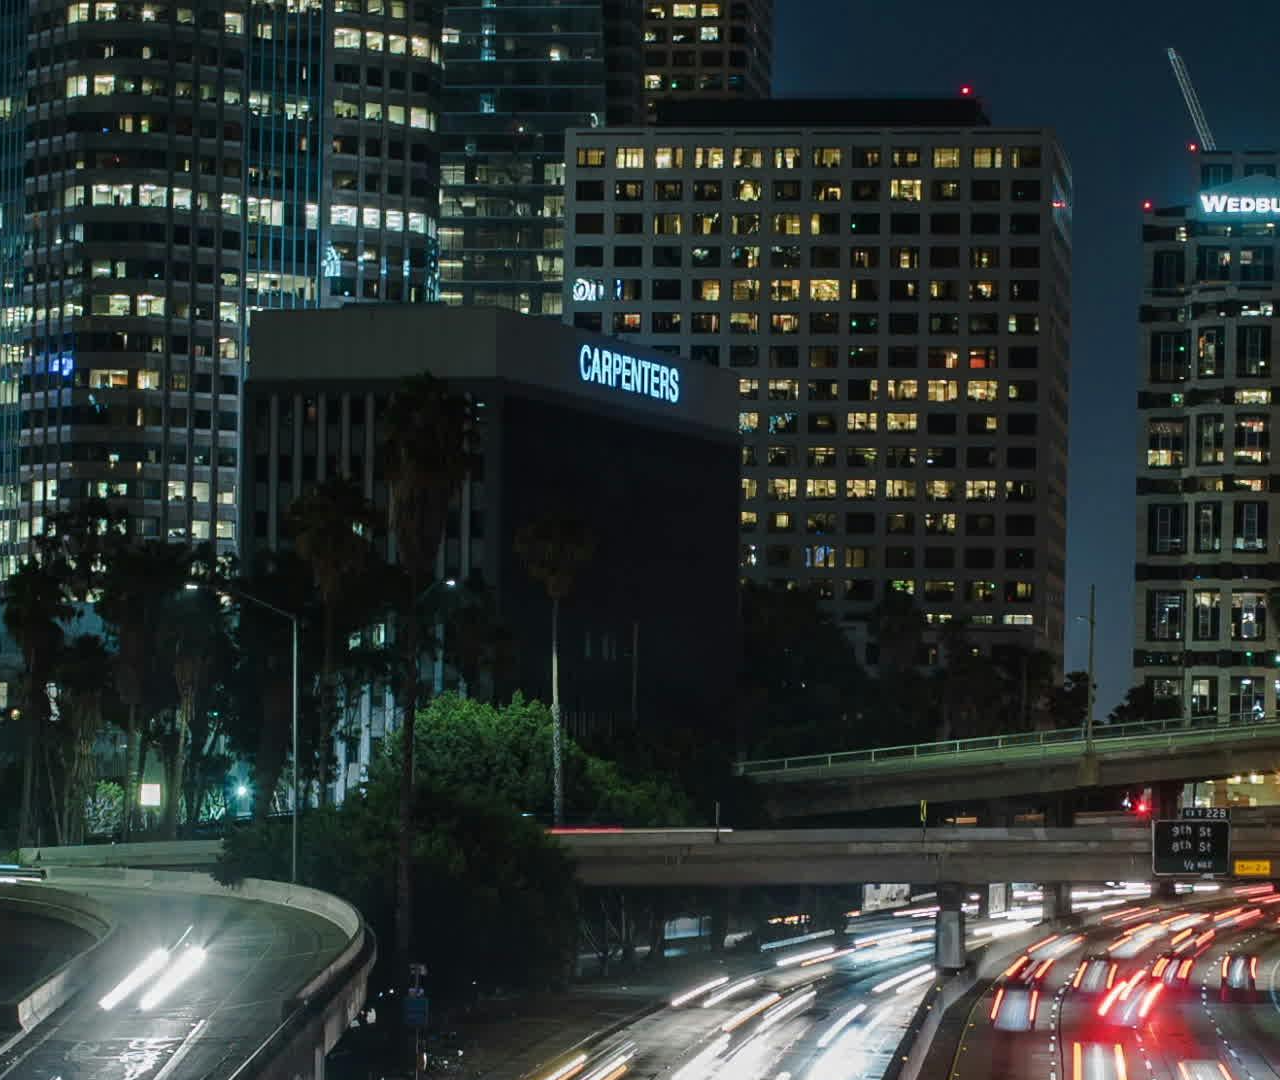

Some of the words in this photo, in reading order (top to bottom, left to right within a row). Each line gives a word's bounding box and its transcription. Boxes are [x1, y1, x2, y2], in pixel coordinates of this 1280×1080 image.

[580, 344, 679, 403] CARPENTERS
[1171, 825, 1192, 837] 9th
[1200, 826, 1212, 837] St
[1172, 841, 1192, 853] 8th
[1200, 842, 1212, 852] St
